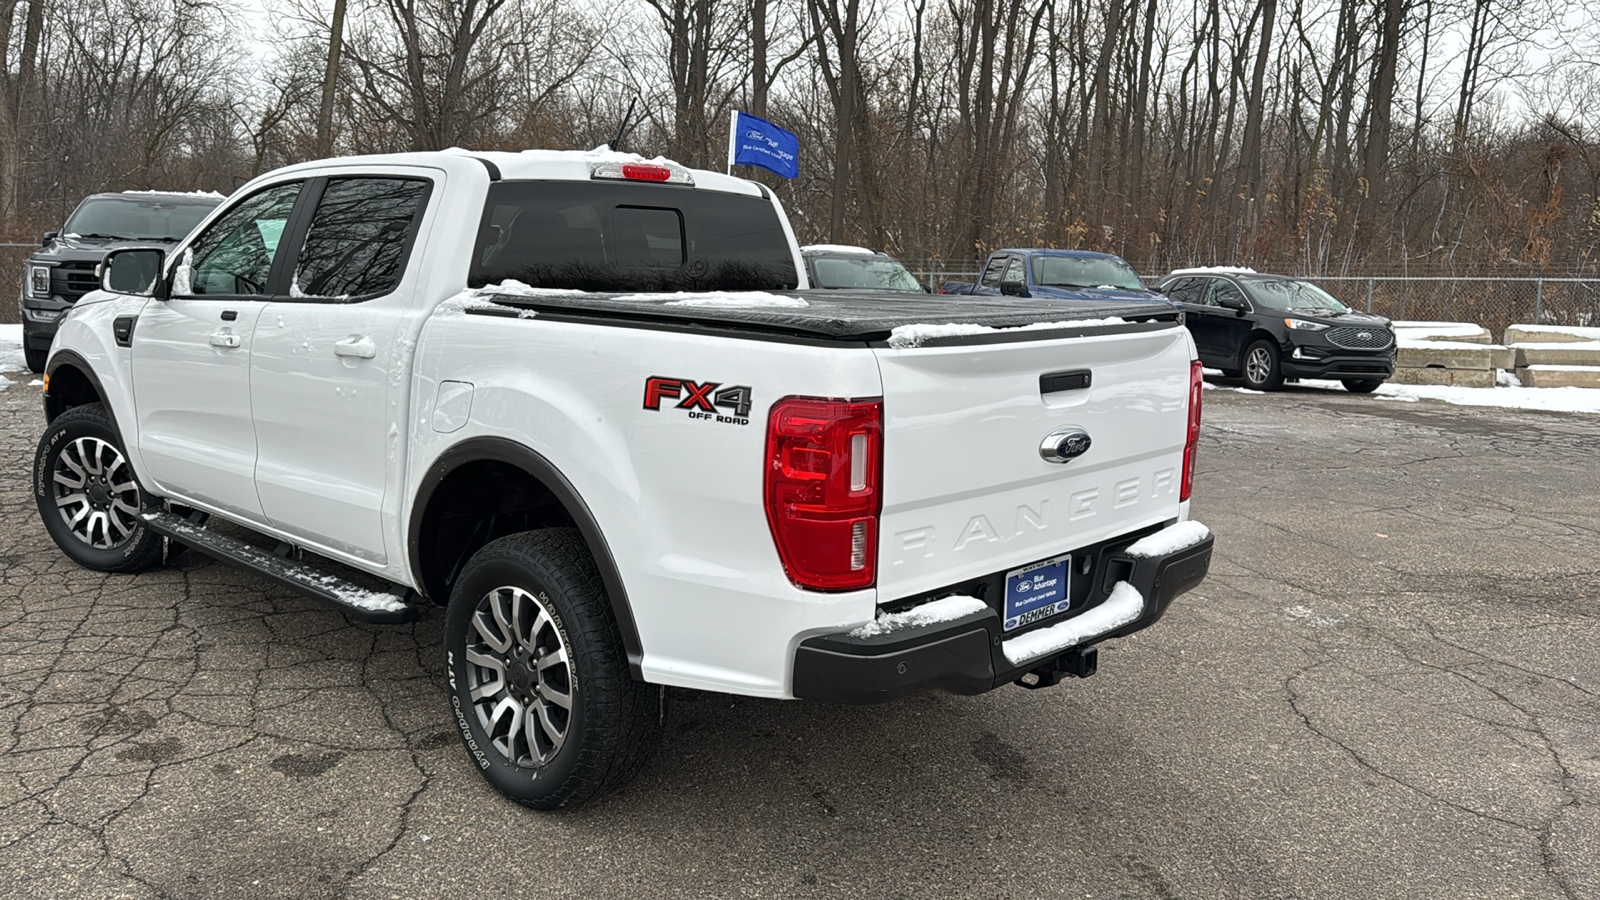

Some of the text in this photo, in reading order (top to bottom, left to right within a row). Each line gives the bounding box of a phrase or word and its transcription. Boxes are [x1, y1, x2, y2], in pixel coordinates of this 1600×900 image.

[643, 375, 753, 418] FX4
[688, 411, 749, 426] OFF ROAD
[1065, 437, 1086, 454] Ford
[893, 467, 1176, 566] RANGER
[1018, 581, 1031, 591] Ford
[1033, 578, 1058, 591] Advantage
[1019, 604, 1056, 625] DEMMER
[452, 695, 490, 770] Dynapro
